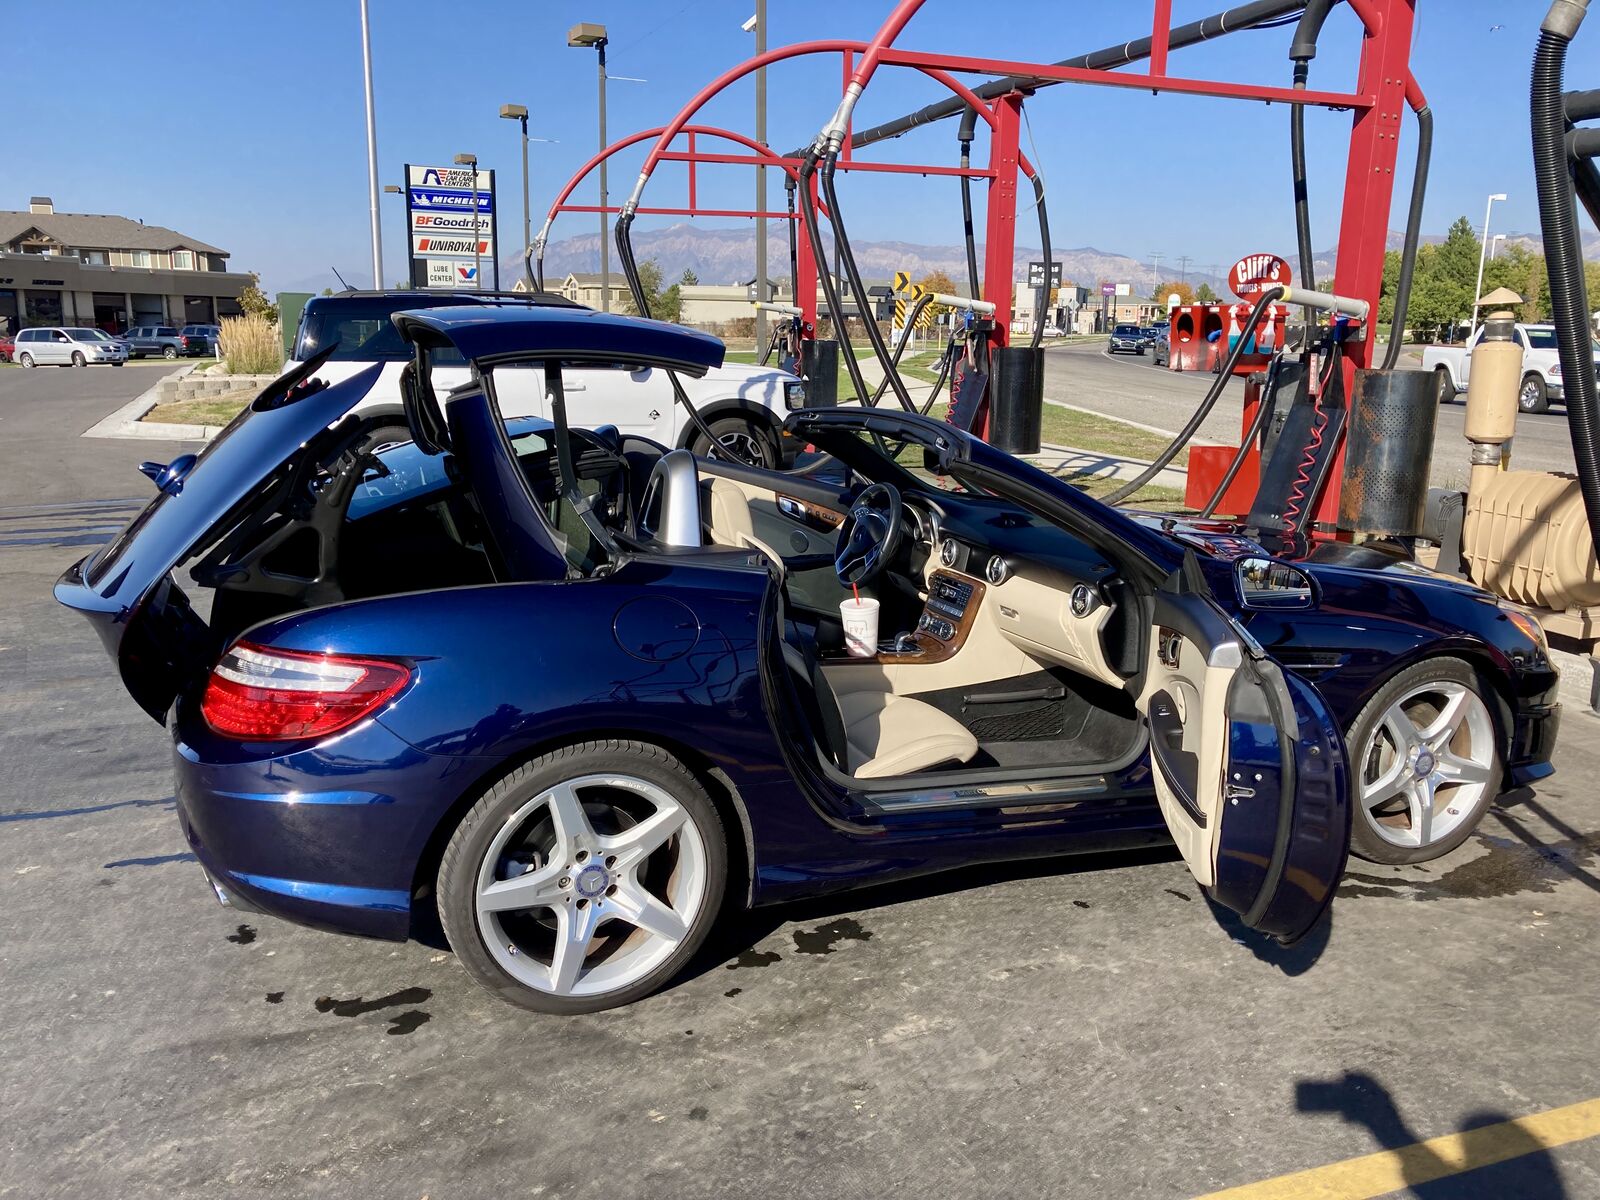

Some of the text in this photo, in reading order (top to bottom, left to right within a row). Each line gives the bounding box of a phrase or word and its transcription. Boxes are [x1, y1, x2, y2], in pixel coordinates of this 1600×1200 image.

[432, 196, 489, 206] MICHELIN
[415, 216, 489, 228] BFGoodrich
[429, 240, 476, 252] UNIROYAL
[433, 265, 449, 273] LUBE
[1237, 256, 1280, 283] Cliff's
[429, 274, 453, 282] CENTER
[1236, 283, 1258, 293] TOWELS
